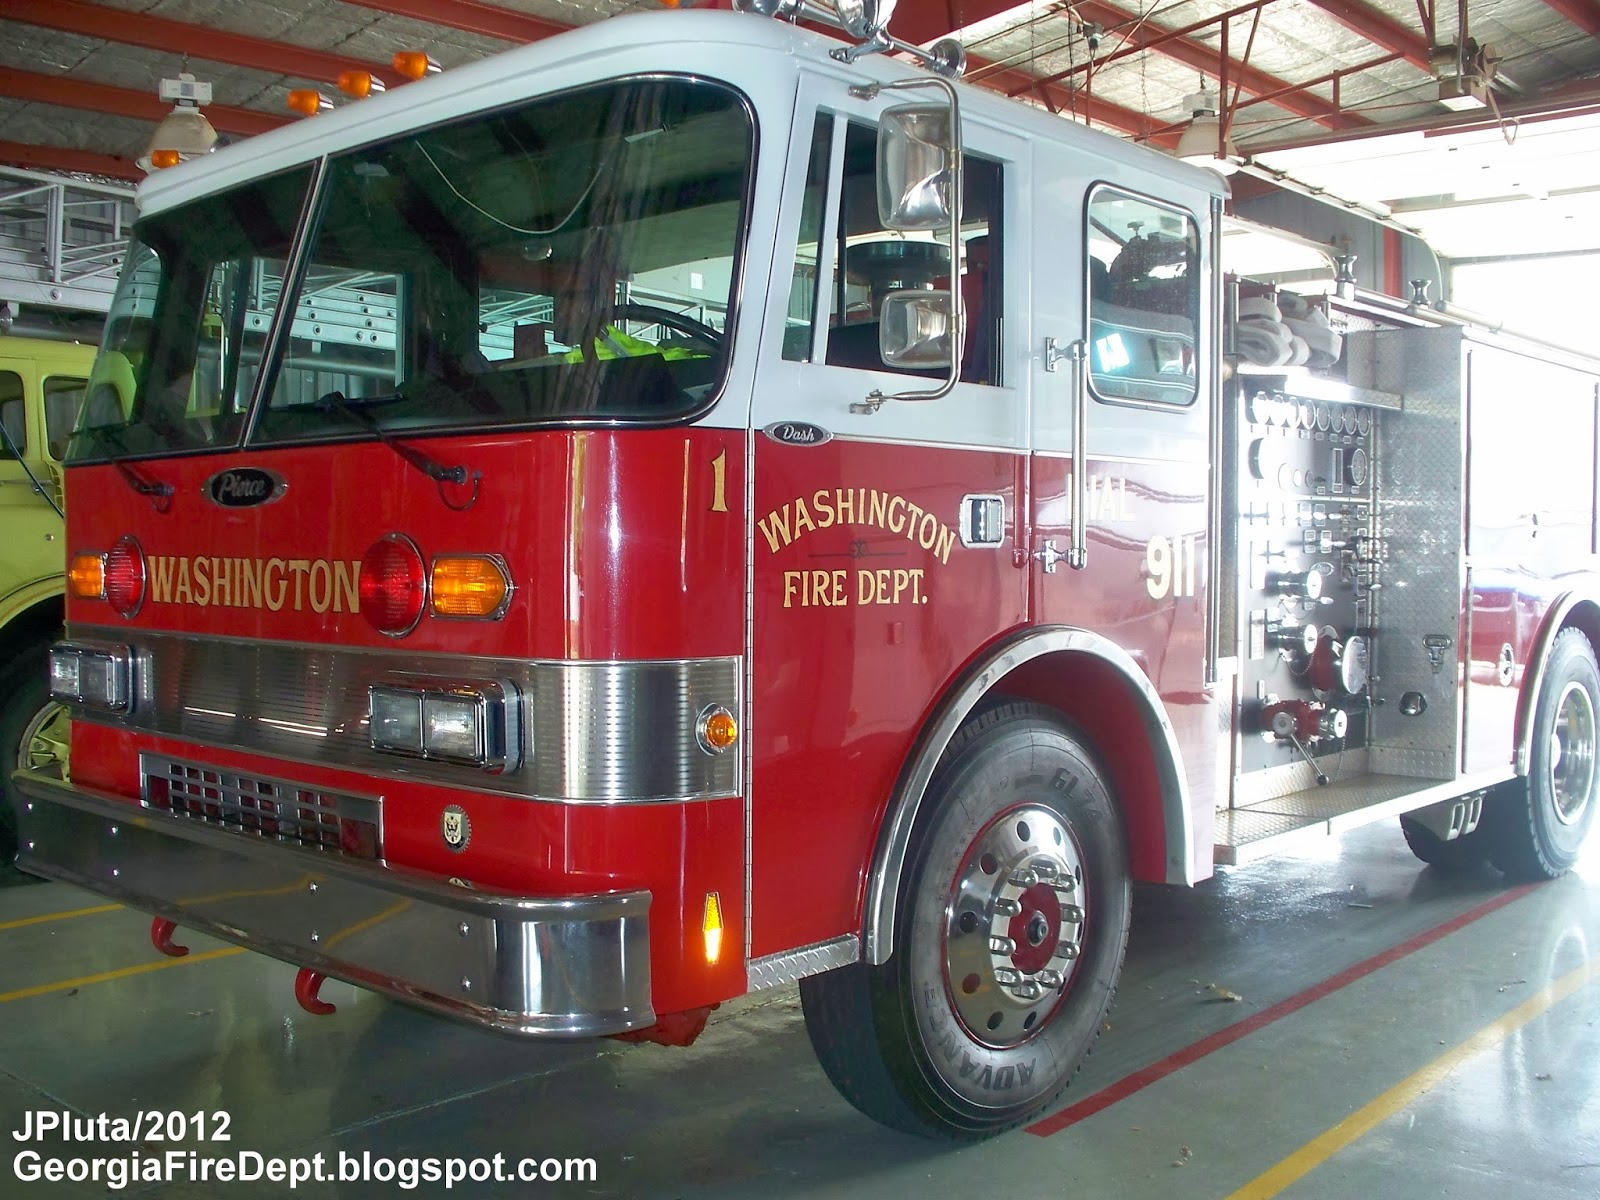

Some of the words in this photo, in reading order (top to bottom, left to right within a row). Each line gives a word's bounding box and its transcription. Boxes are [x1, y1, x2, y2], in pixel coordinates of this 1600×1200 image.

[782, 424, 815, 442] Dash
[217, 473, 266, 502] Pierce
[708, 448, 728, 512] 1
[757, 488, 956, 565] WASHINGTON
[147, 555, 362, 613] WASHINGTON
[783, 569, 847, 608] FIRE
[857, 569, 928, 606] DEPT.
[1146, 535, 1195, 599] 911
